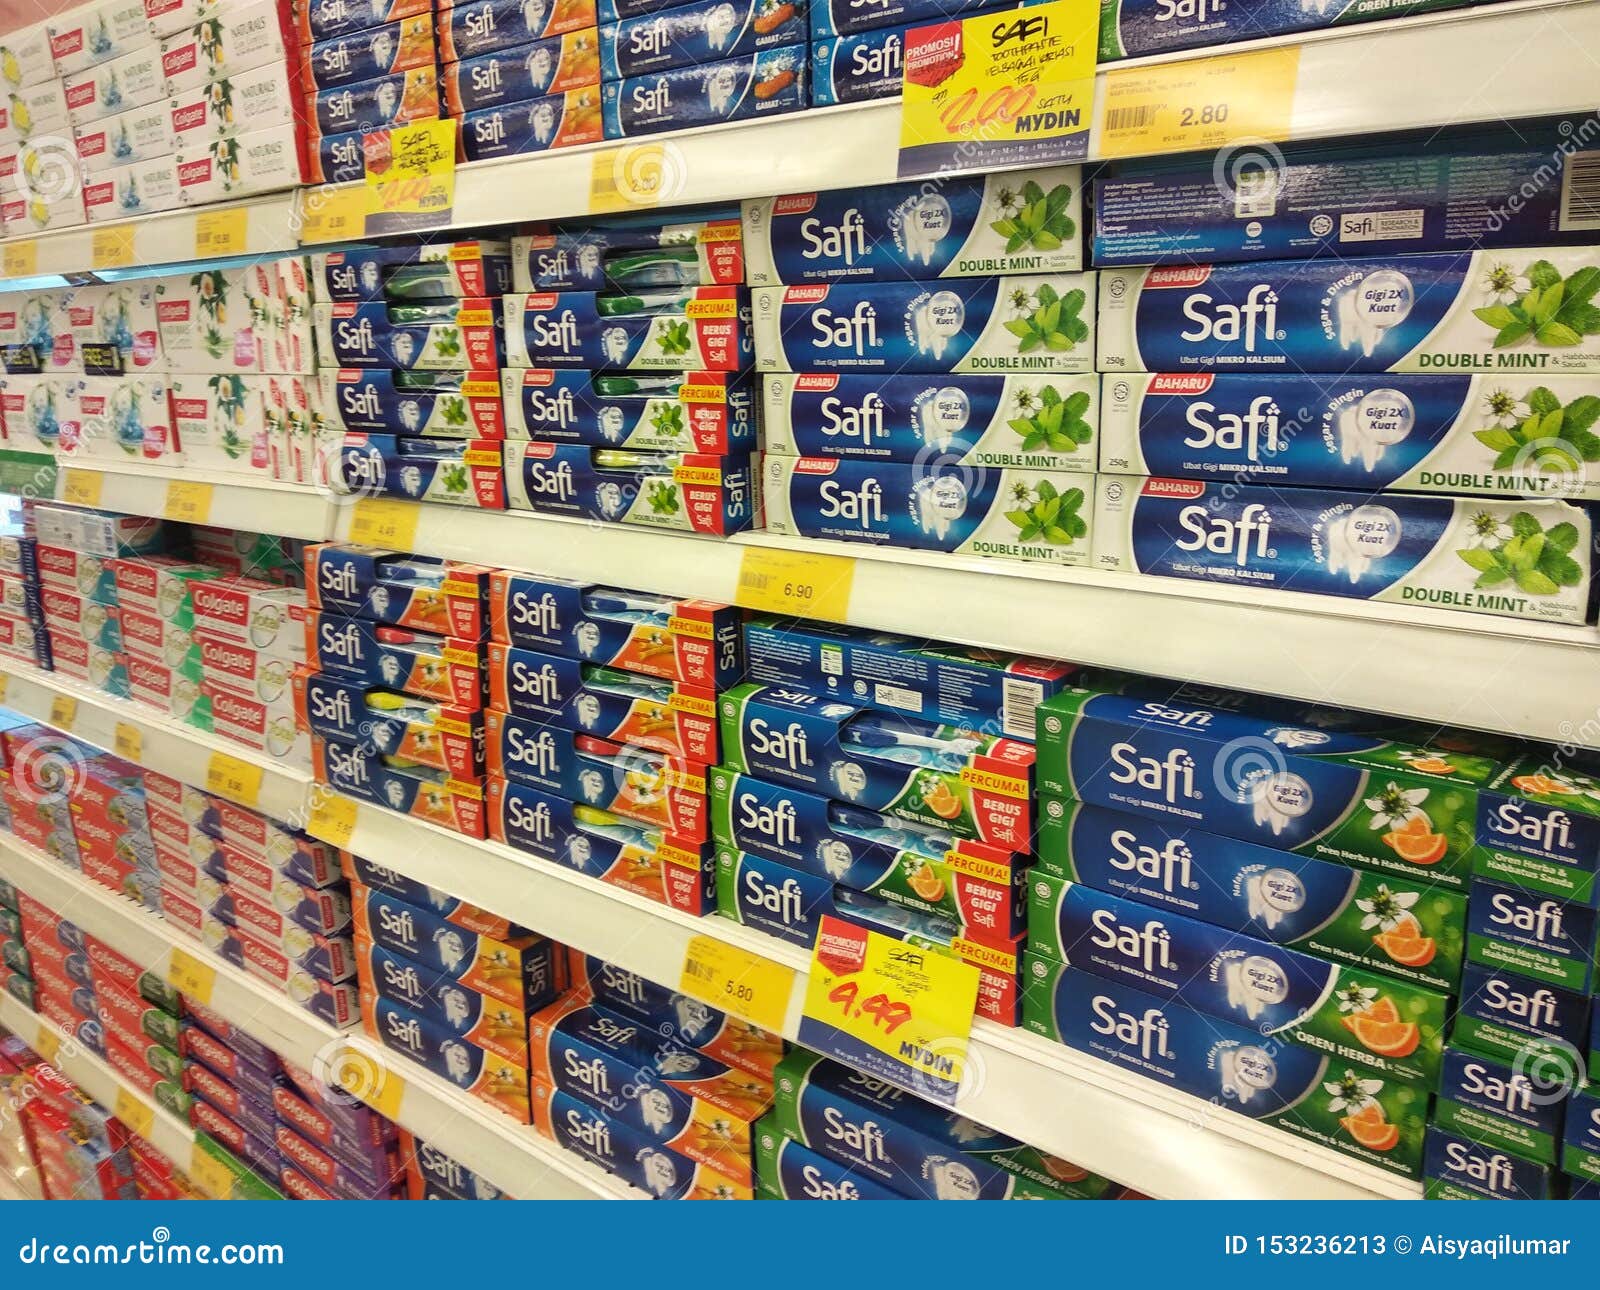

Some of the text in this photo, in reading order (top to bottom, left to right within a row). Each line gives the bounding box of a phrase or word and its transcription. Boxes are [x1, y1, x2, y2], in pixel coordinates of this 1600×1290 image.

[631, 17, 669, 54] Safi
[992, 16, 1048, 48] SAFI
[472, 59, 501, 92] Safi
[633, 78, 669, 115] Safi
[940, 84, 1036, 134] 2.00
[476, 112, 504, 143] Safi
[1016, 109, 1081, 133] MYDIN
[1180, 104, 1228, 127] 2.80
[802, 209, 865, 266] Safi
[538, 249, 569, 281] Safi
[959, 256, 1043, 272] DOUBLE MINT
[1151, 267, 1206, 284] BAHARU
[1364, 289, 1404, 302] Gigi 2X
[1368, 302, 1396, 313] Kuat
[534, 309, 579, 354] Safi
[702, 324, 731, 336] BERUS
[811, 301, 877, 356] Safi
[1181, 284, 1279, 352] Safi
[338, 316, 374, 355] Safi
[707, 337, 727, 348] GIGI
[971, 356, 1054, 369] DOUBLE MINT
[1105, 356, 1126, 366] 250g
[1246, 356, 1286, 364] KALSIUM
[1155, 376, 1207, 391] BAHARU
[345, 383, 382, 423] Safi
[531, 386, 576, 429] Safi
[820, 392, 885, 446] Safi
[1365, 407, 1404, 419] Gigi 2X
[1185, 396, 1279, 461] Safi
[1369, 420, 1398, 431] Kuat
[976, 453, 1058, 468] DOUBLE MINT
[1108, 458, 1129, 468] 250g
[1248, 465, 1288, 474] KALSIUM
[532, 460, 574, 501] Safi
[1420, 471, 1550, 492] DOUBLE MINT
[820, 478, 882, 529] Safi
[1176, 503, 1269, 566] Safi
[1354, 520, 1392, 532] Gigi 2X
[1357, 533, 1383, 544] Kuat
[973, 541, 1054, 560] DOUBLE MINT
[1100, 554, 1120, 566] 250g
[115, 567, 156, 592] Colgate
[321, 562, 358, 599] Safi
[783, 581, 814, 601] 6.90
[1237, 569, 1275, 581] KALSIUM
[194, 588, 246, 618] Colgate
[513, 592, 558, 634] Safi
[1402, 586, 1528, 613] DOUBLE MINT
[201, 643, 252, 672] Colgate
[321, 623, 362, 664] Safi
[512, 662, 558, 704] Safi
[212, 694, 264, 724] Colgate
[310, 687, 352, 729] Safi
[507, 728, 556, 776] Safi
[750, 718, 807, 773] Safi
[962, 770, 1026, 796] PERCUMA!
[1110, 742, 1195, 804] Safi
[221, 807, 266, 838] Colgate
[508, 797, 552, 842] Safi
[739, 793, 798, 845] Safi
[983, 798, 1022, 817] BERUS
[988, 812, 1016, 828] GIGI
[992, 825, 1015, 844] Safi
[1497, 804, 1572, 851] Safi
[228, 853, 272, 886] Colgate
[947, 854, 1008, 881] PERCUMA!
[1109, 829, 1192, 892] Safi
[746, 870, 801, 922] Safi
[965, 882, 1004, 901] BERUS
[971, 897, 997, 913] GIGI
[972, 910, 995, 929] Safi
[1490, 893, 1563, 941] Safi
[952, 942, 1014, 970] PERCUMA!
[1091, 909, 1171, 971] Safi
[725, 979, 753, 1003] 5.80
[1483, 979, 1557, 1028] Safi
[1090, 995, 1169, 1059] Safi
[899, 1041, 953, 1074] MYDIN
[1296, 1031, 1387, 1069] OREN HERBA
[565, 1048, 609, 1096] Safi
[1460, 1063, 1532, 1112] Safi
[567, 1109, 611, 1156] Safi
[823, 1107, 885, 1162] Safi
[1445, 1142, 1513, 1192] Safi
